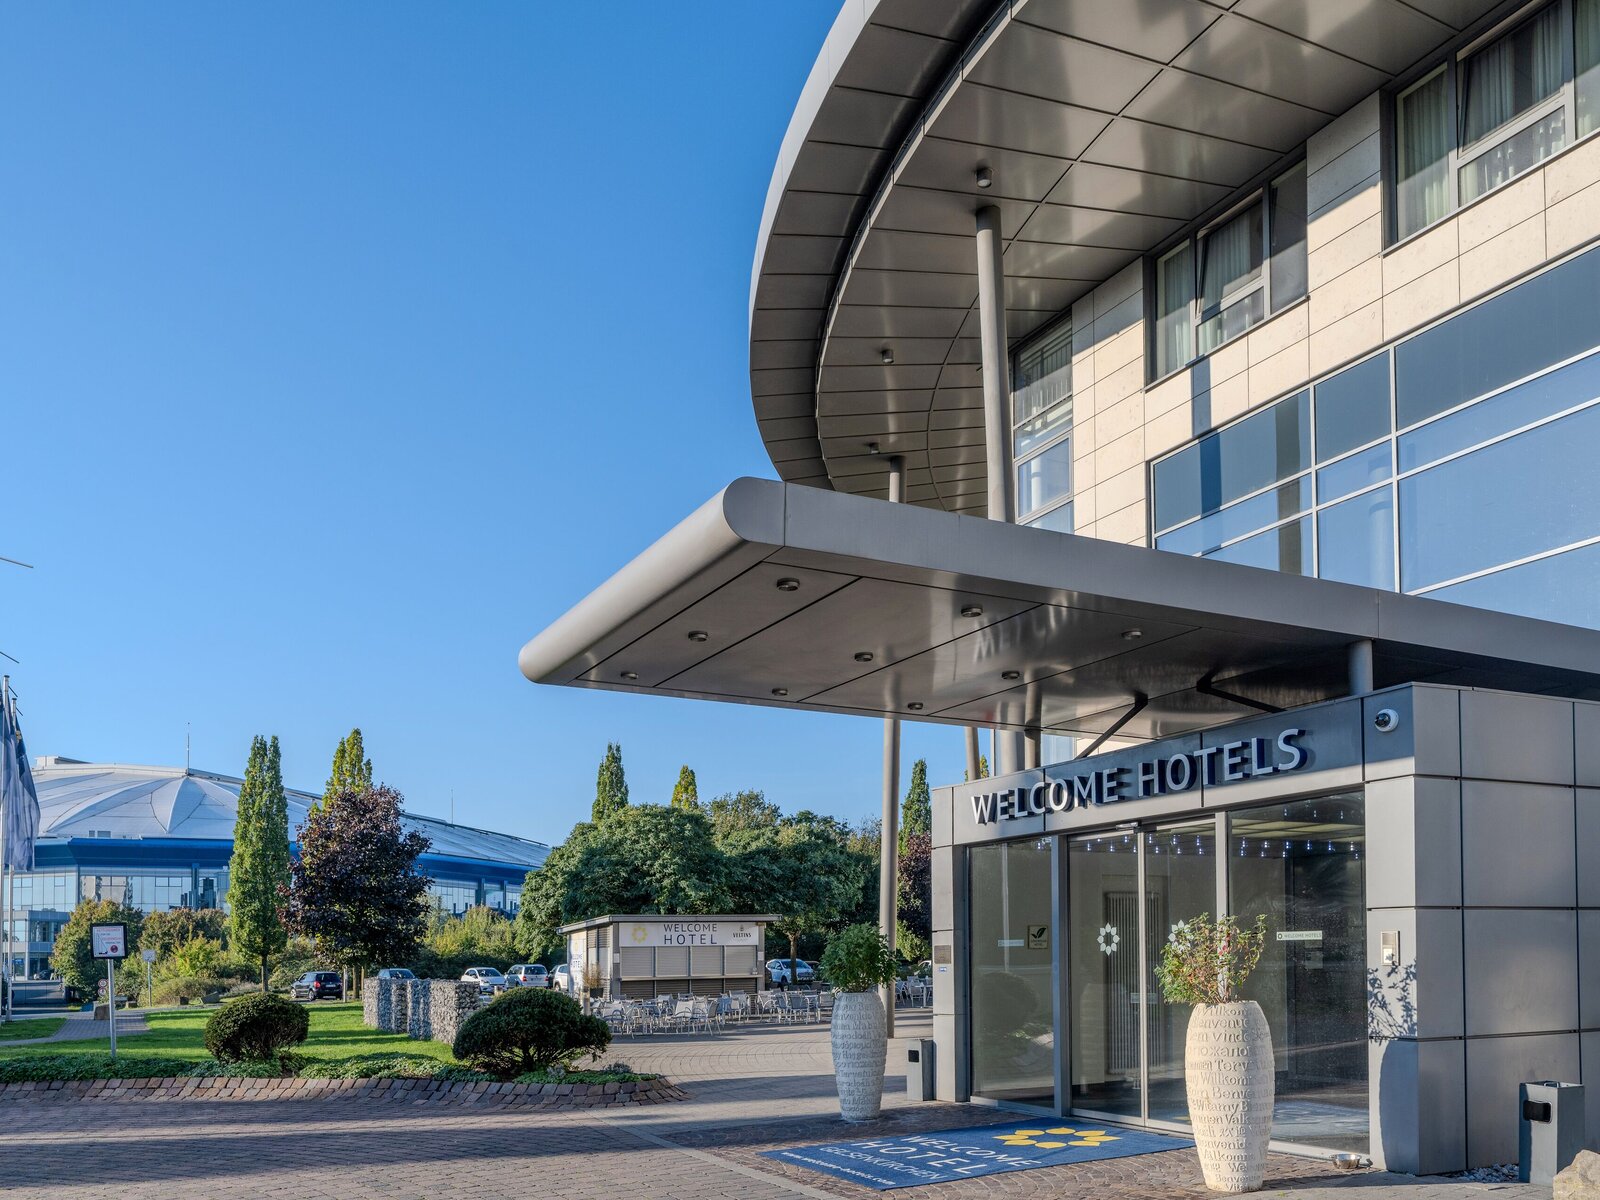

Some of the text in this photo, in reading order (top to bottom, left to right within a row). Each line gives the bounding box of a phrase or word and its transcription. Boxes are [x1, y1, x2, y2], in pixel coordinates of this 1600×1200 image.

[970, 728, 1304, 824] WELCOME HOTELS
[663, 923, 718, 933] WELCOME
[663, 933, 718, 945] HOTEL
[819, 1146, 947, 1180] GELSENKIRCHEN
[851, 1140, 988, 1174] HOTEL
[901, 1135, 1042, 1168] WELCOME
